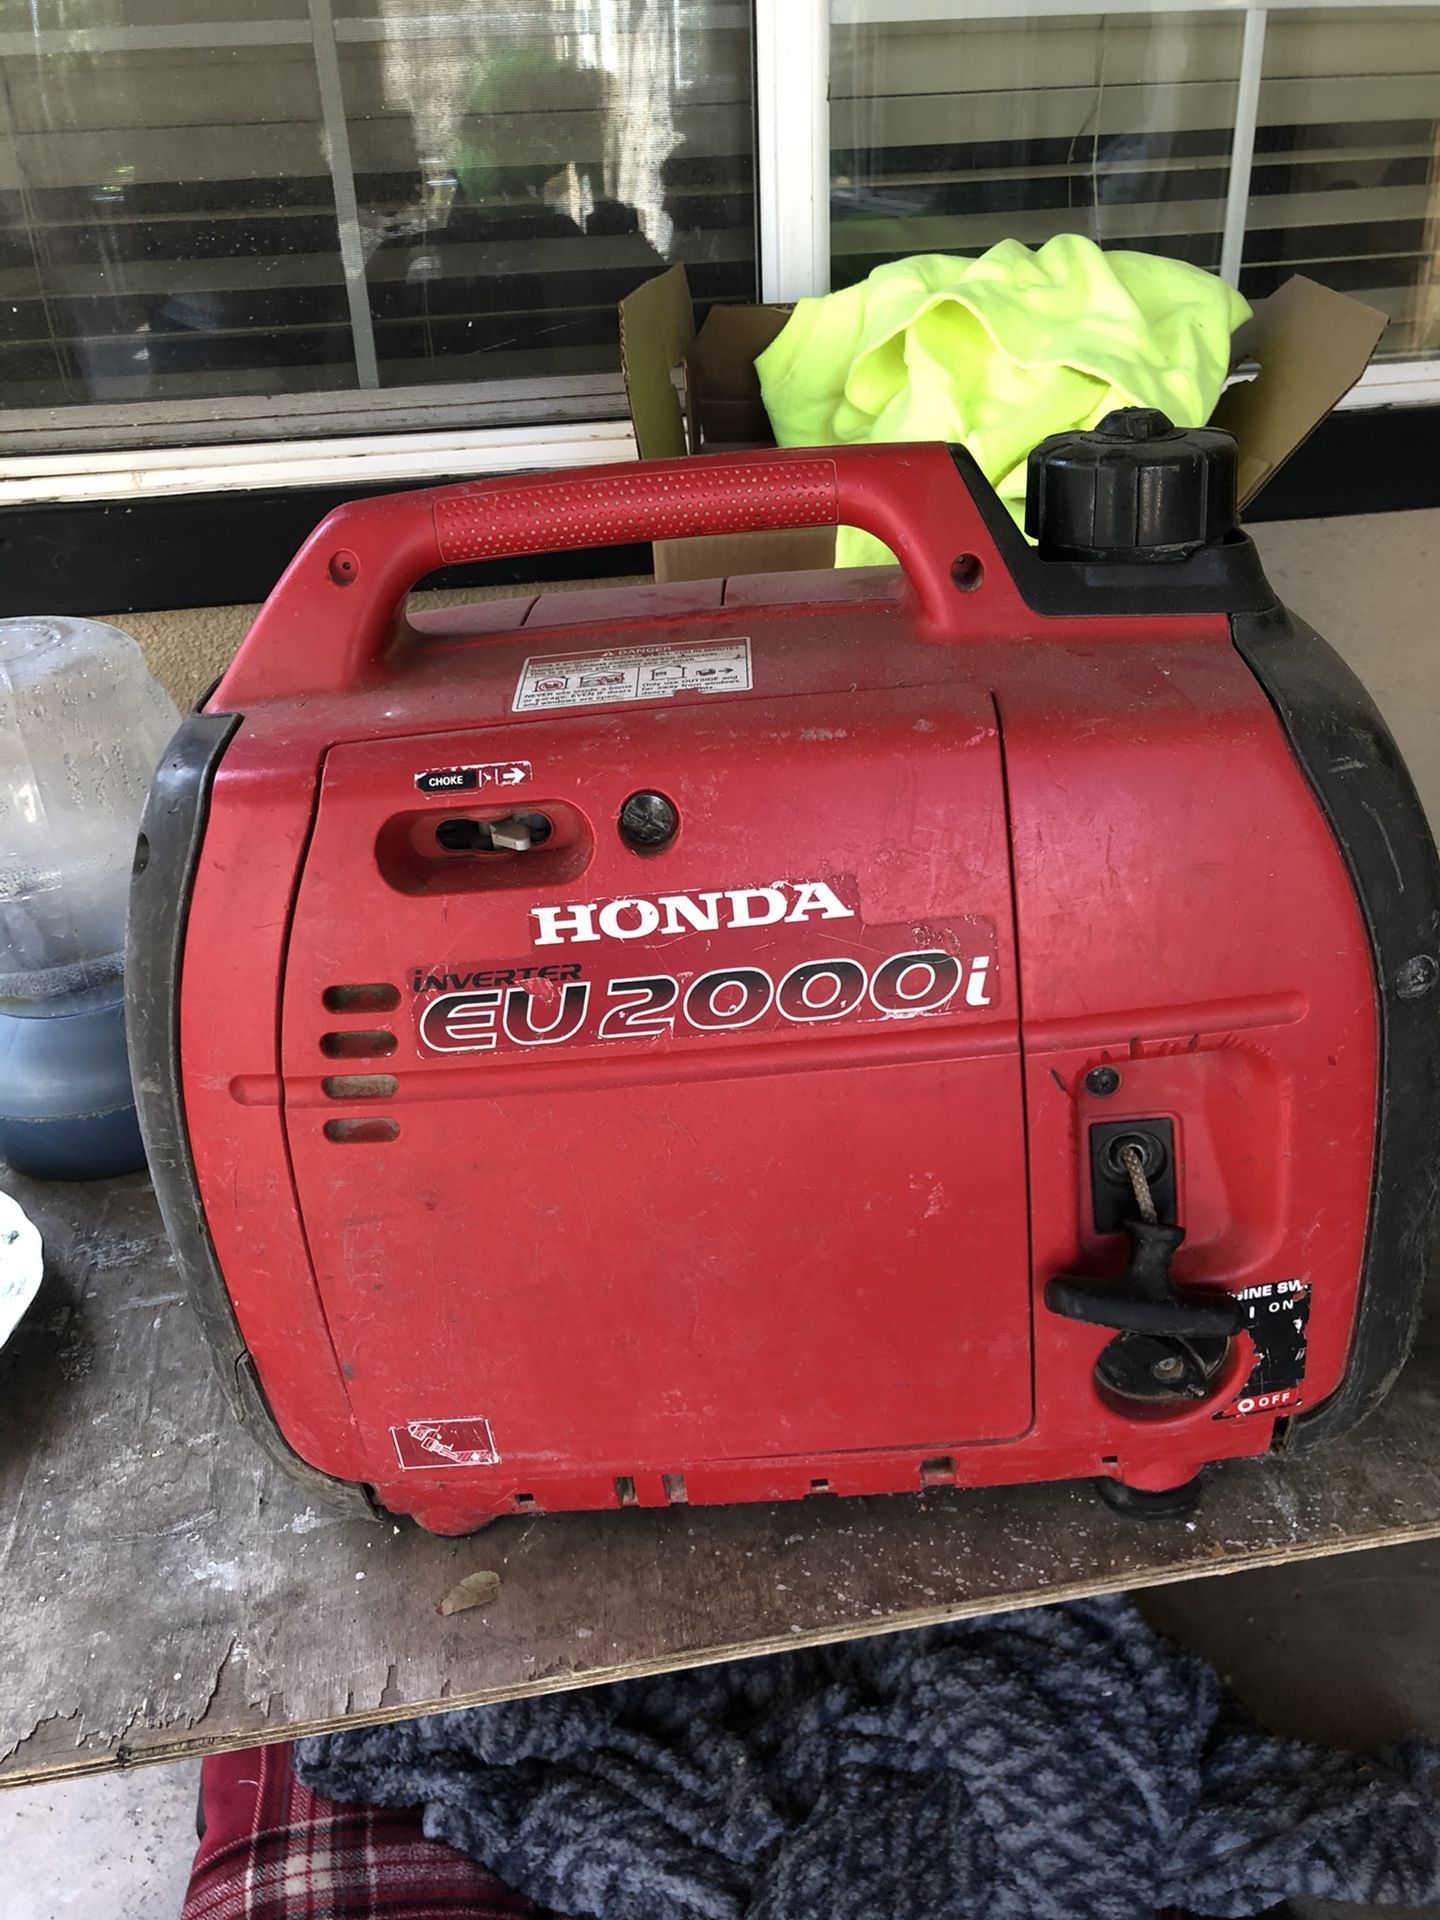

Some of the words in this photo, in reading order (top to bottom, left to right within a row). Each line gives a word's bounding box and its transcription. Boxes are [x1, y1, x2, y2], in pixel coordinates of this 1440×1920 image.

[618, 646, 672, 656] DANGER
[428, 775, 463, 787] CHOKE
[531, 881, 855, 946] HONDA
[1269, 1300, 1294, 1313] ON
[1258, 1392, 1290, 1407] OFF
